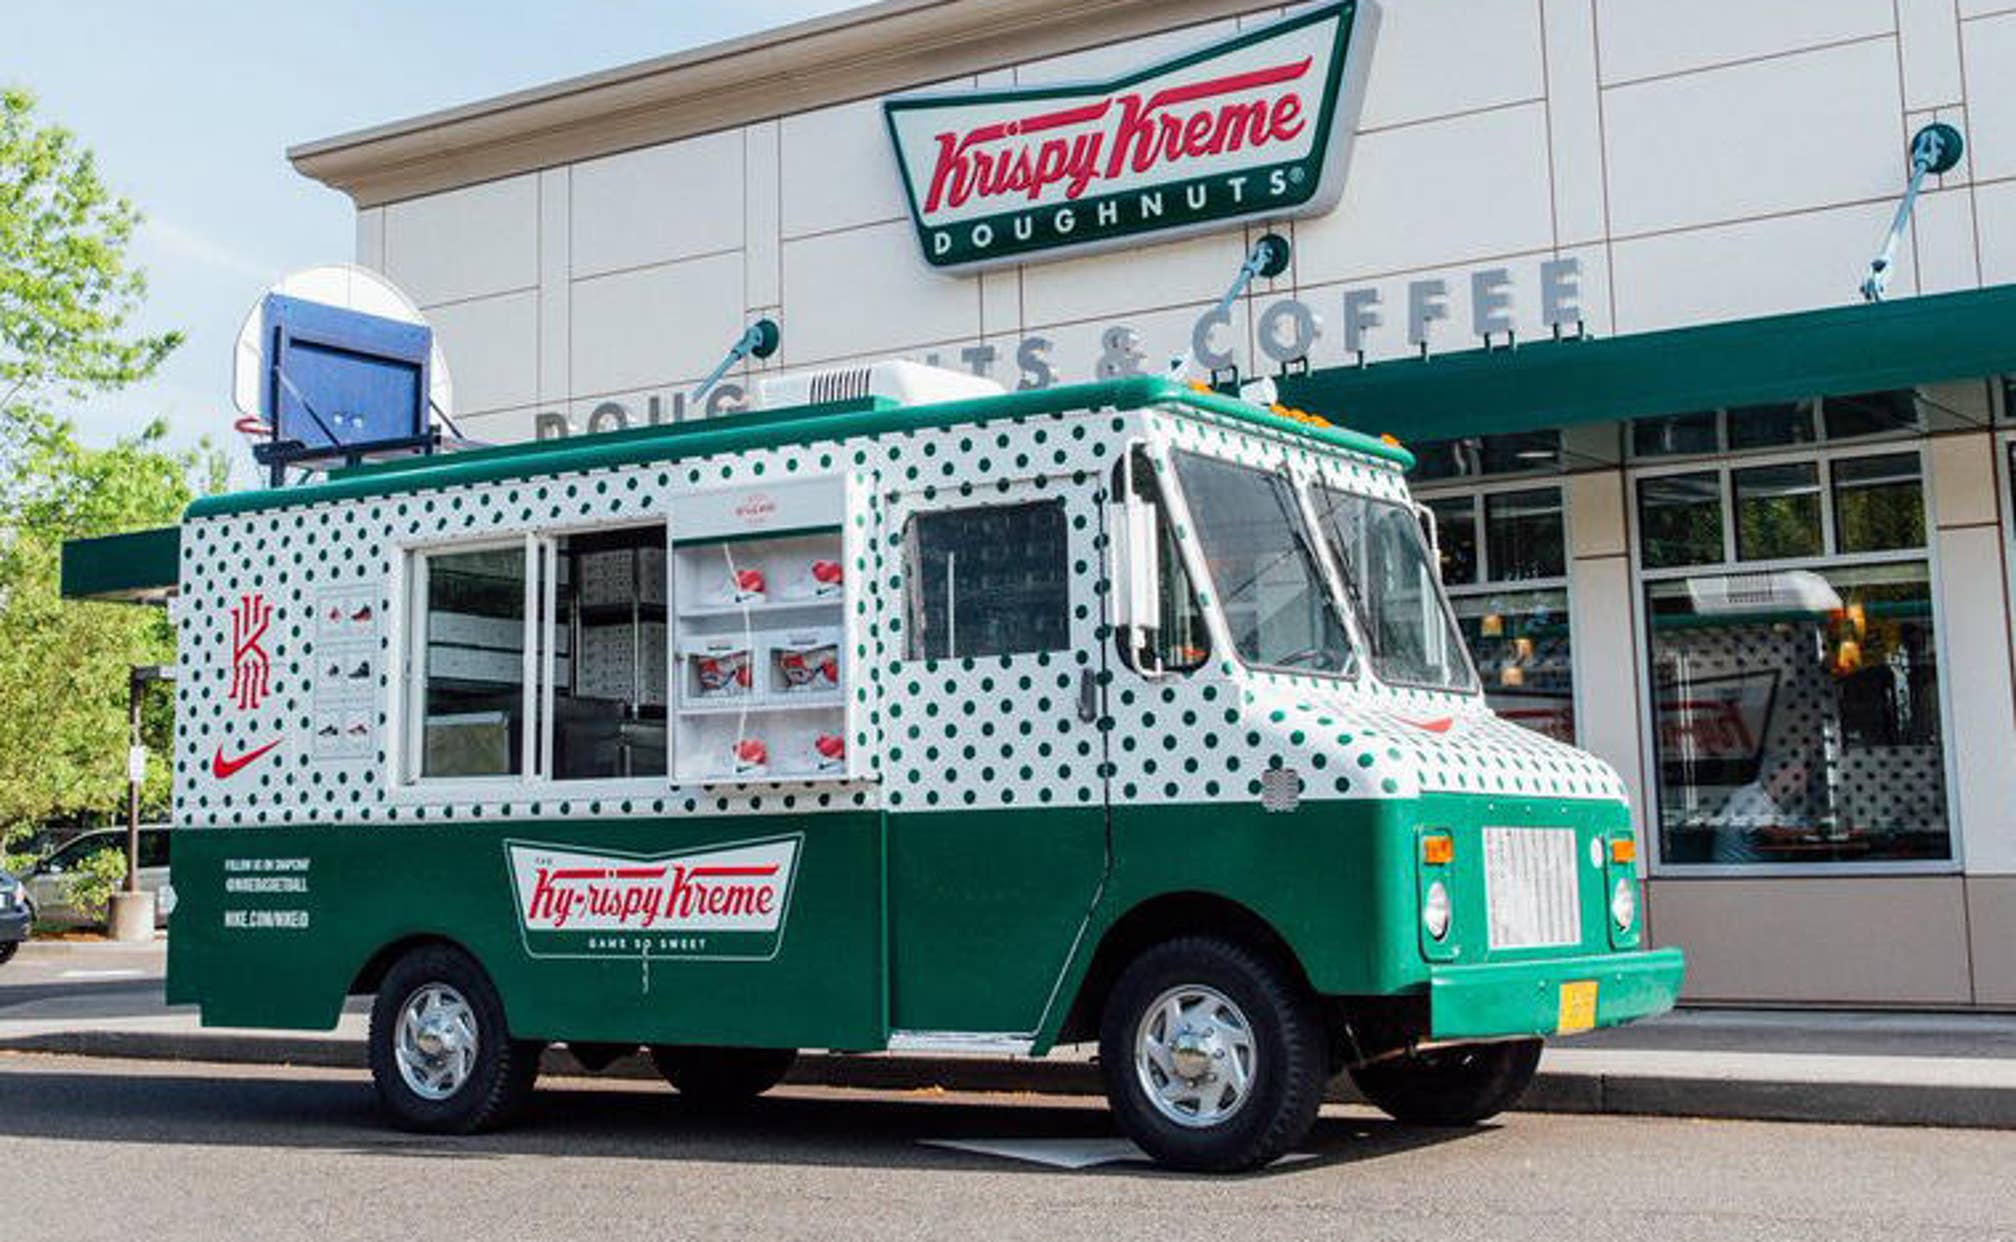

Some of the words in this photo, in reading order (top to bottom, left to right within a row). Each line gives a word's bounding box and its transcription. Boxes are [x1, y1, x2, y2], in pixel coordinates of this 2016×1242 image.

[924, 99, 1113, 213] Krispy
[1105, 55, 1313, 178] Kreme
[933, 174, 1286, 255] DOUGHNUTS
[1192, 257, 1582, 370] COFFEE
[665, 862, 780, 919] Kreme
